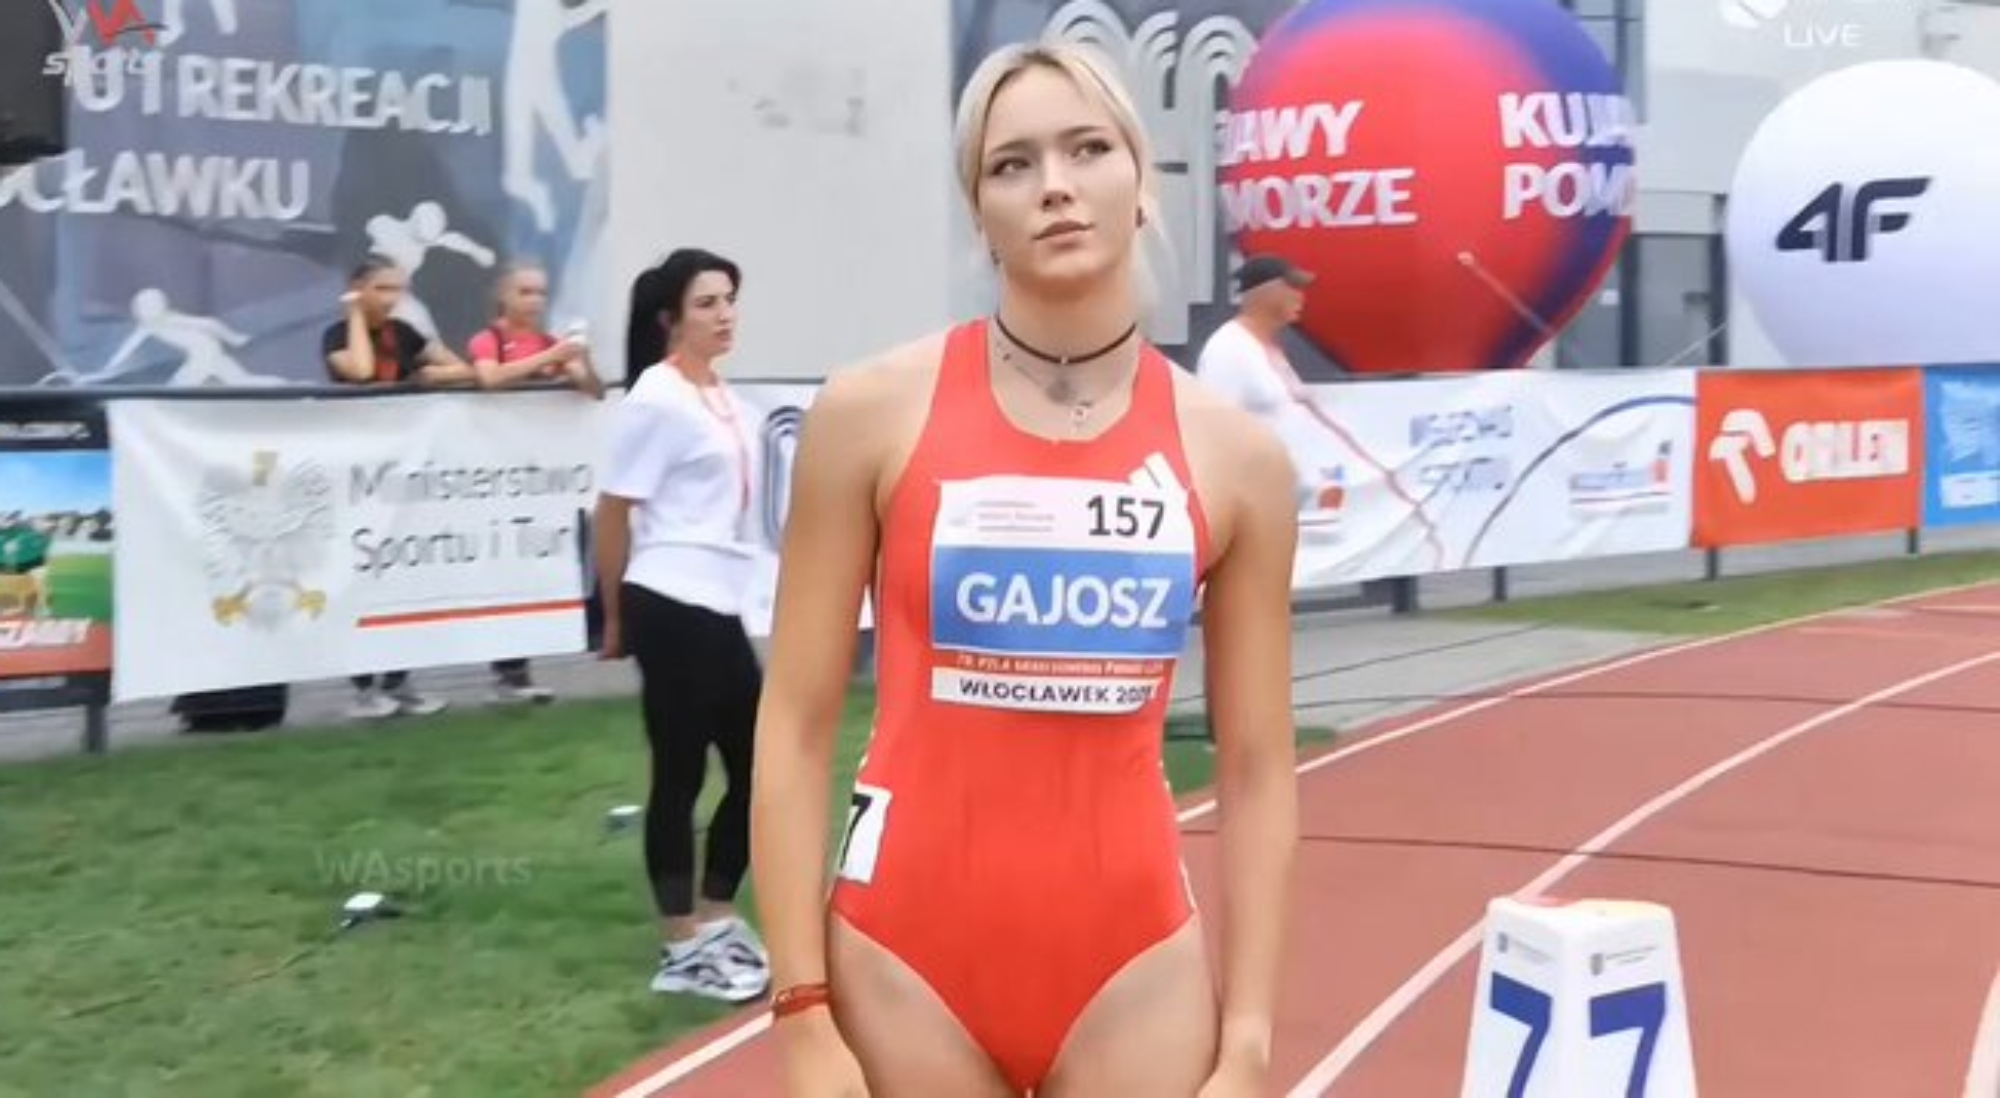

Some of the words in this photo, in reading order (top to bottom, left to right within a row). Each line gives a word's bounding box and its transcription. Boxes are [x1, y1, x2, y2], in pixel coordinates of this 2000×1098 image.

[177, 54, 494, 137] REKREACJI
[1773, 175, 1934, 263] 4F
[349, 459, 593, 506] Mnisterstwo
[1086, 494, 1166, 540] 157
[955, 571, 1172, 629] GAJOSZ
[958, 676, 1110, 704] WŁOCŁAWEK
[1115, 685, 1154, 705] 20
[1489, 971, 1553, 1098] 7
[1588, 980, 1667, 1098] 7
